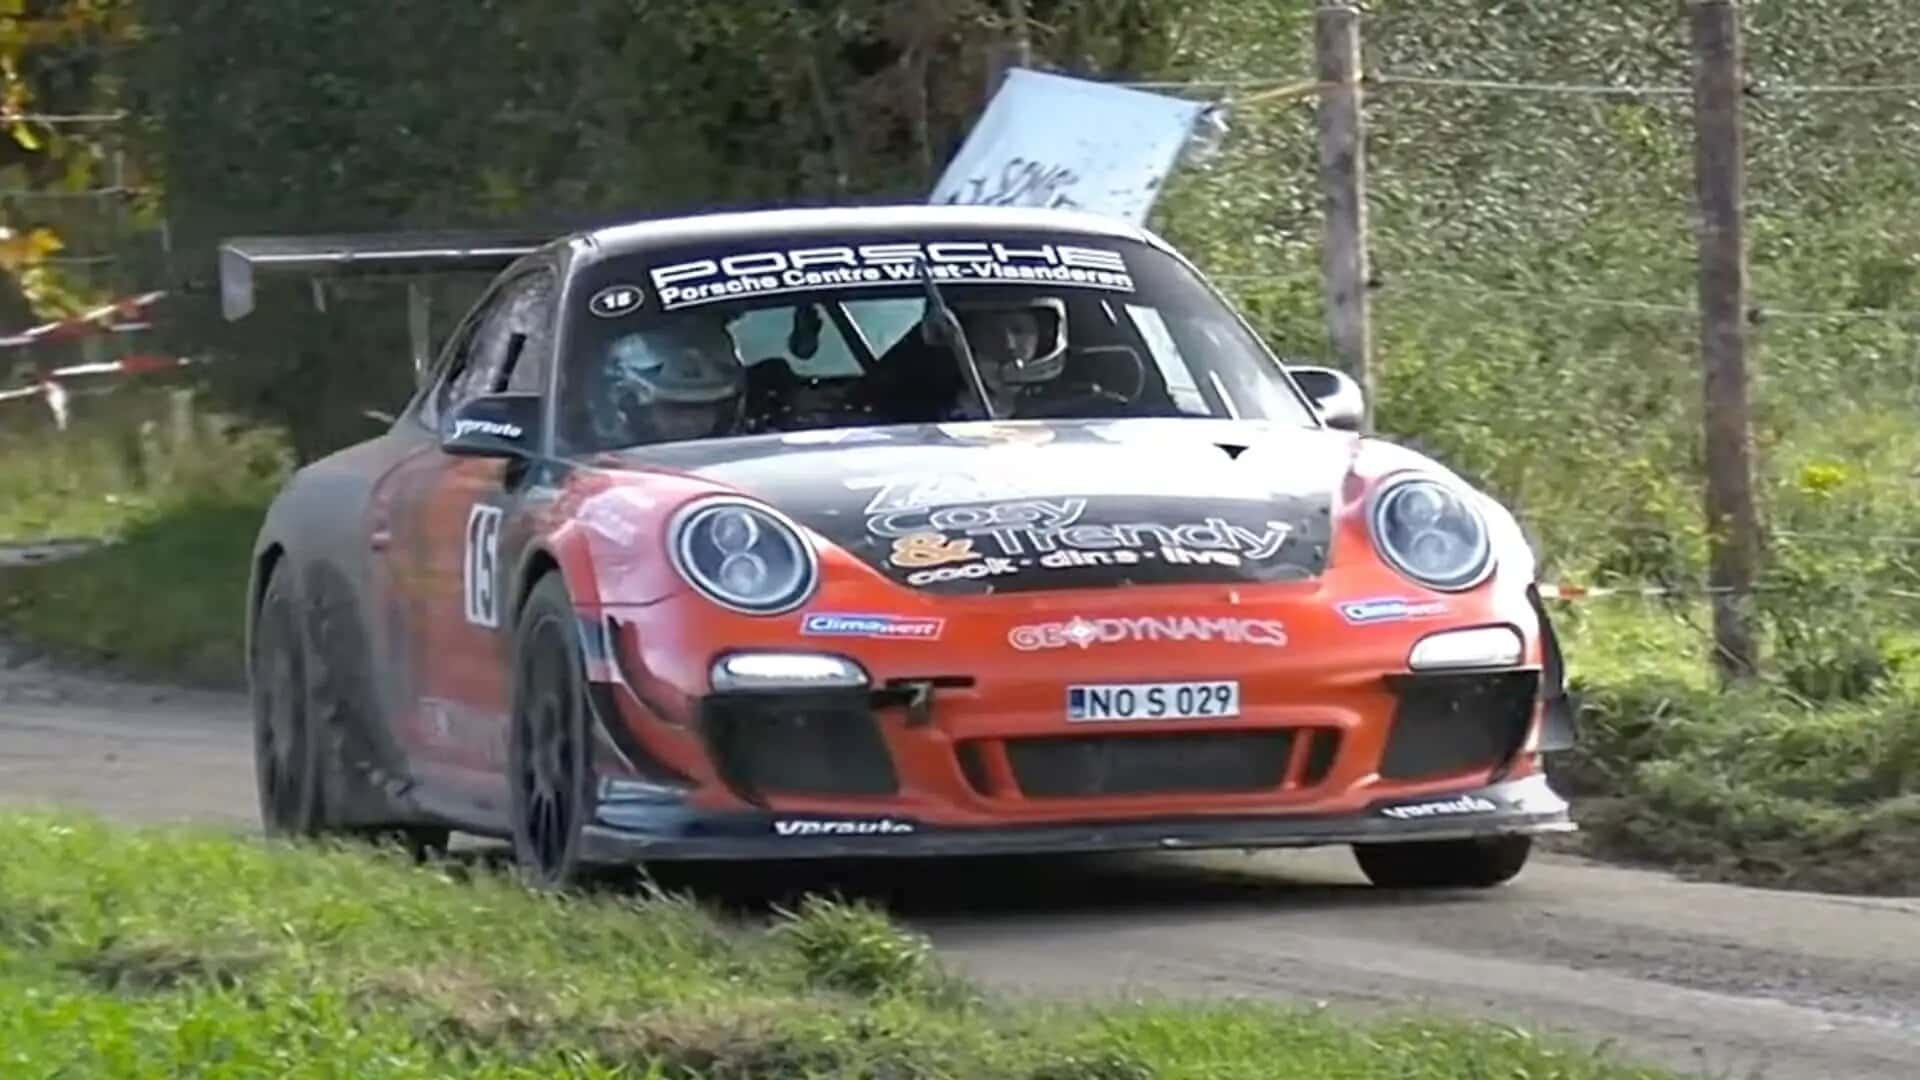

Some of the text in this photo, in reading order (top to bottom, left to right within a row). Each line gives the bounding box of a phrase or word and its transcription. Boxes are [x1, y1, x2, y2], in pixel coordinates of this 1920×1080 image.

[650, 243, 1126, 289] PORSCHE
[658, 273, 779, 304] Porsche
[783, 263, 880, 286] Centre
[866, 497, 1088, 538] Cosy
[890, 517, 1293, 567] & Trendy
[469, 509, 498, 621] 15
[907, 557, 1019, 585] cook
[1160, 545, 1241, 567] live
[1007, 615, 1288, 651] GEODYNAMICS
[1089, 684, 1233, 717] NO S 029
